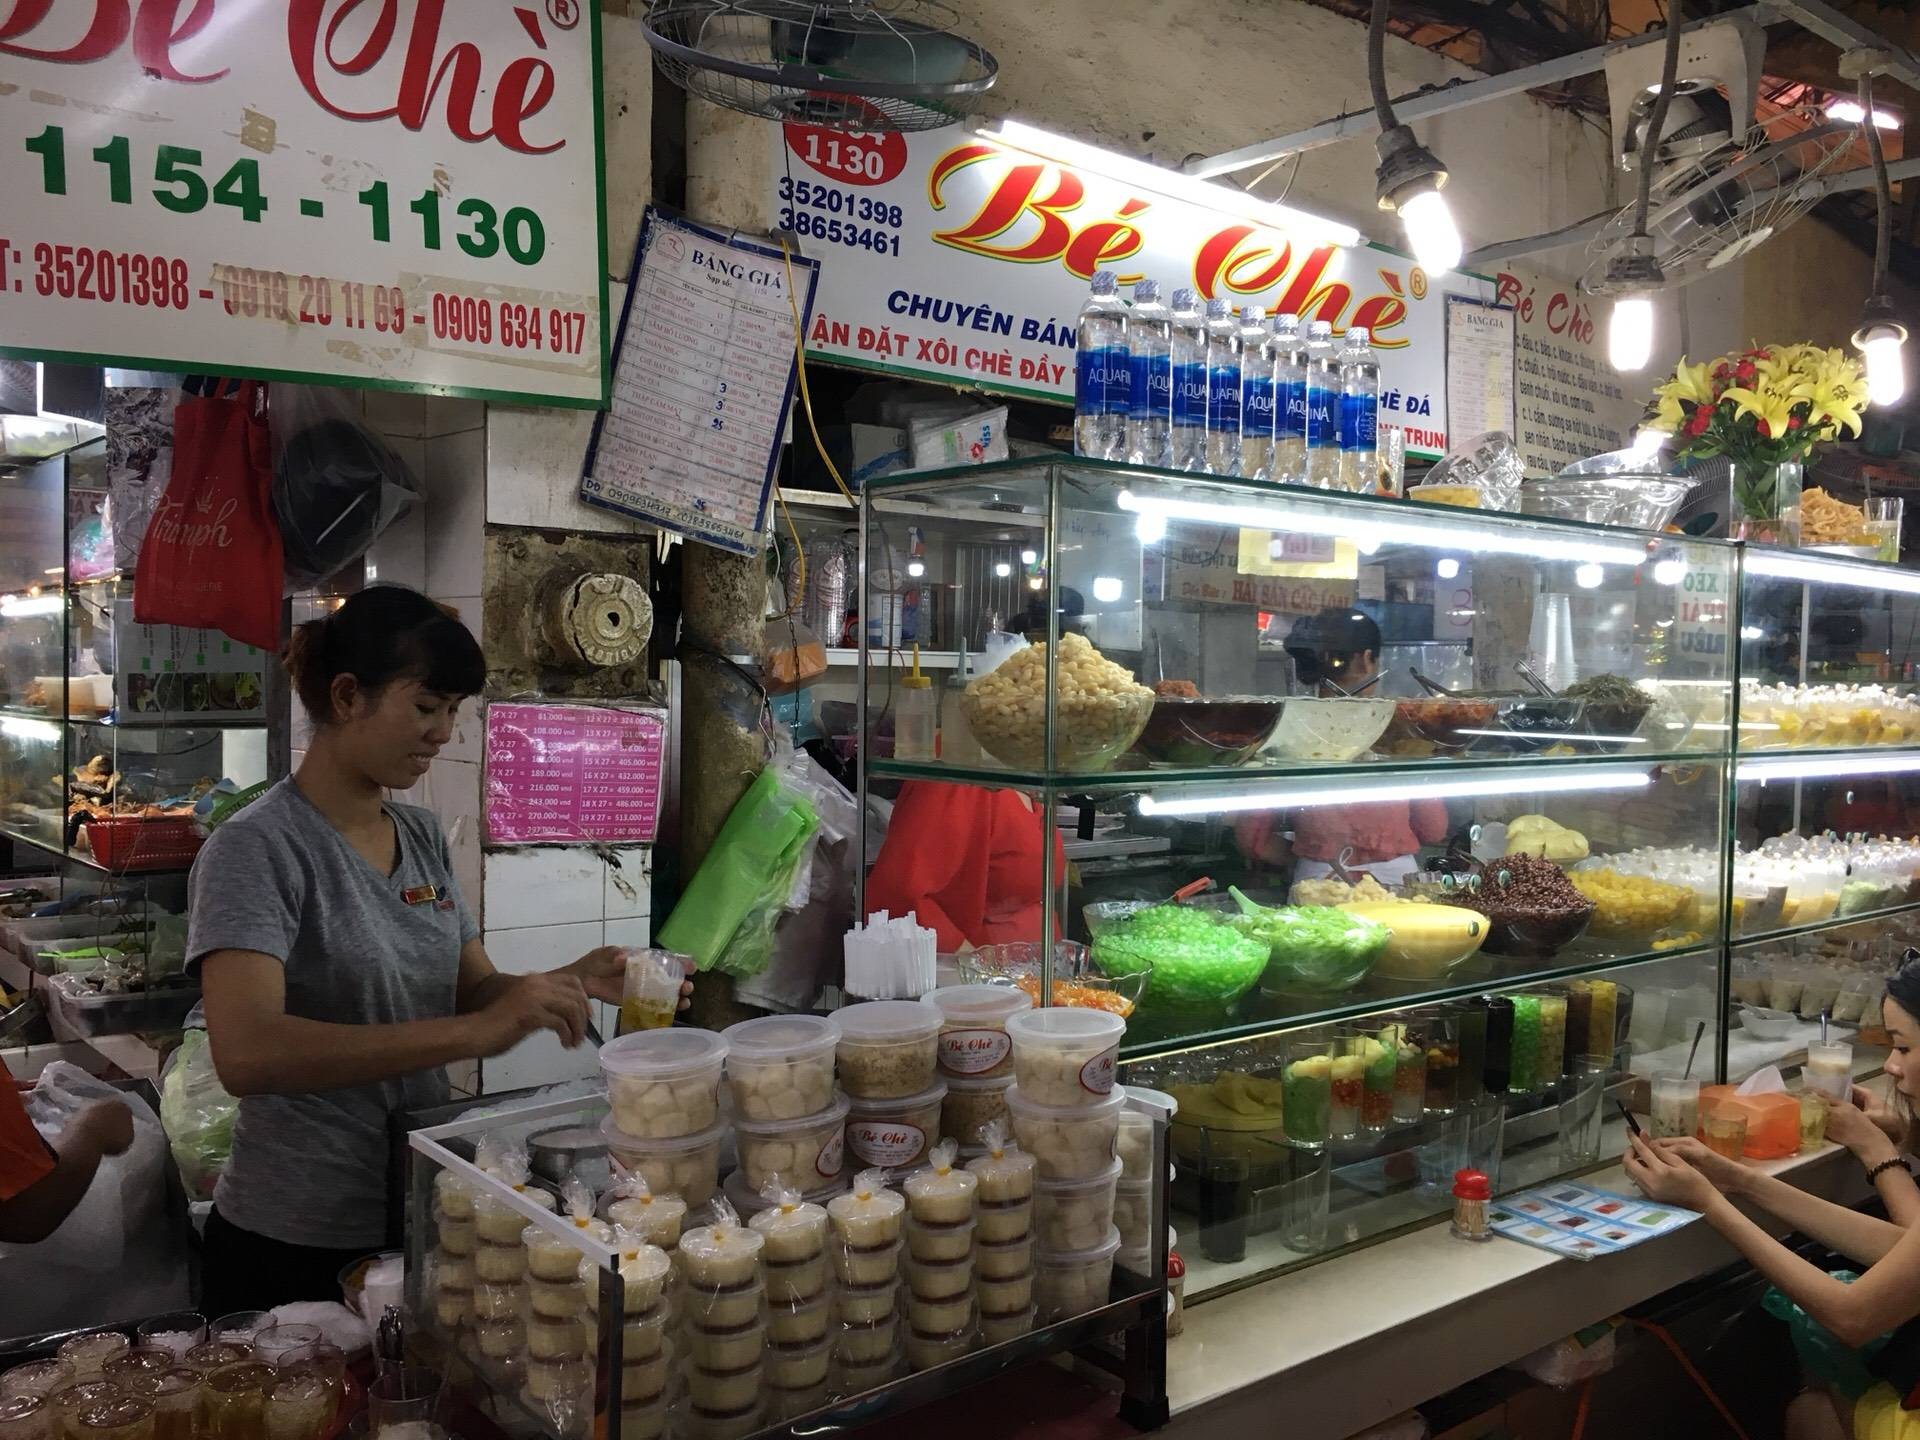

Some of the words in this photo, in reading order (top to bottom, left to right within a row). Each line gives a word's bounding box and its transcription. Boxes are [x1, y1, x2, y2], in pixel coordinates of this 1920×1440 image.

[806, 134, 884, 180] 1130
[26, 125, 268, 223] 1154
[359, 181, 546, 265] 1130
[779, 176, 903, 228] 35201398
[779, 207, 900, 257] 38653461
[928, 144, 1151, 283] Bé
[1193, 224, 1412, 349] Chè
[692, 250, 744, 279] BẢNG
[749, 271, 781, 289] GIÁ
[34, 242, 189, 310] 35201398
[300, 275, 332, 326] 20
[342, 281, 365, 329] 11
[433, 293, 492, 344] 0909
[501, 302, 542, 350] 634
[550, 309, 586, 355] 917
[888, 290, 1013, 335] CHUYÊN
[1020, 317, 1077, 349] BÁN
[1497, 272, 1535, 323] Bé
[1546, 293, 1595, 344] Chè
[857, 325, 910, 360] ĐẶT
[916, 337, 957, 367] XÔI
[964, 348, 1013, 376] CHÈ
[1019, 353, 1066, 385] ĐẦY
[1406, 394, 1431, 416] ĐÁ
[1404, 427, 1449, 449] TRUN
